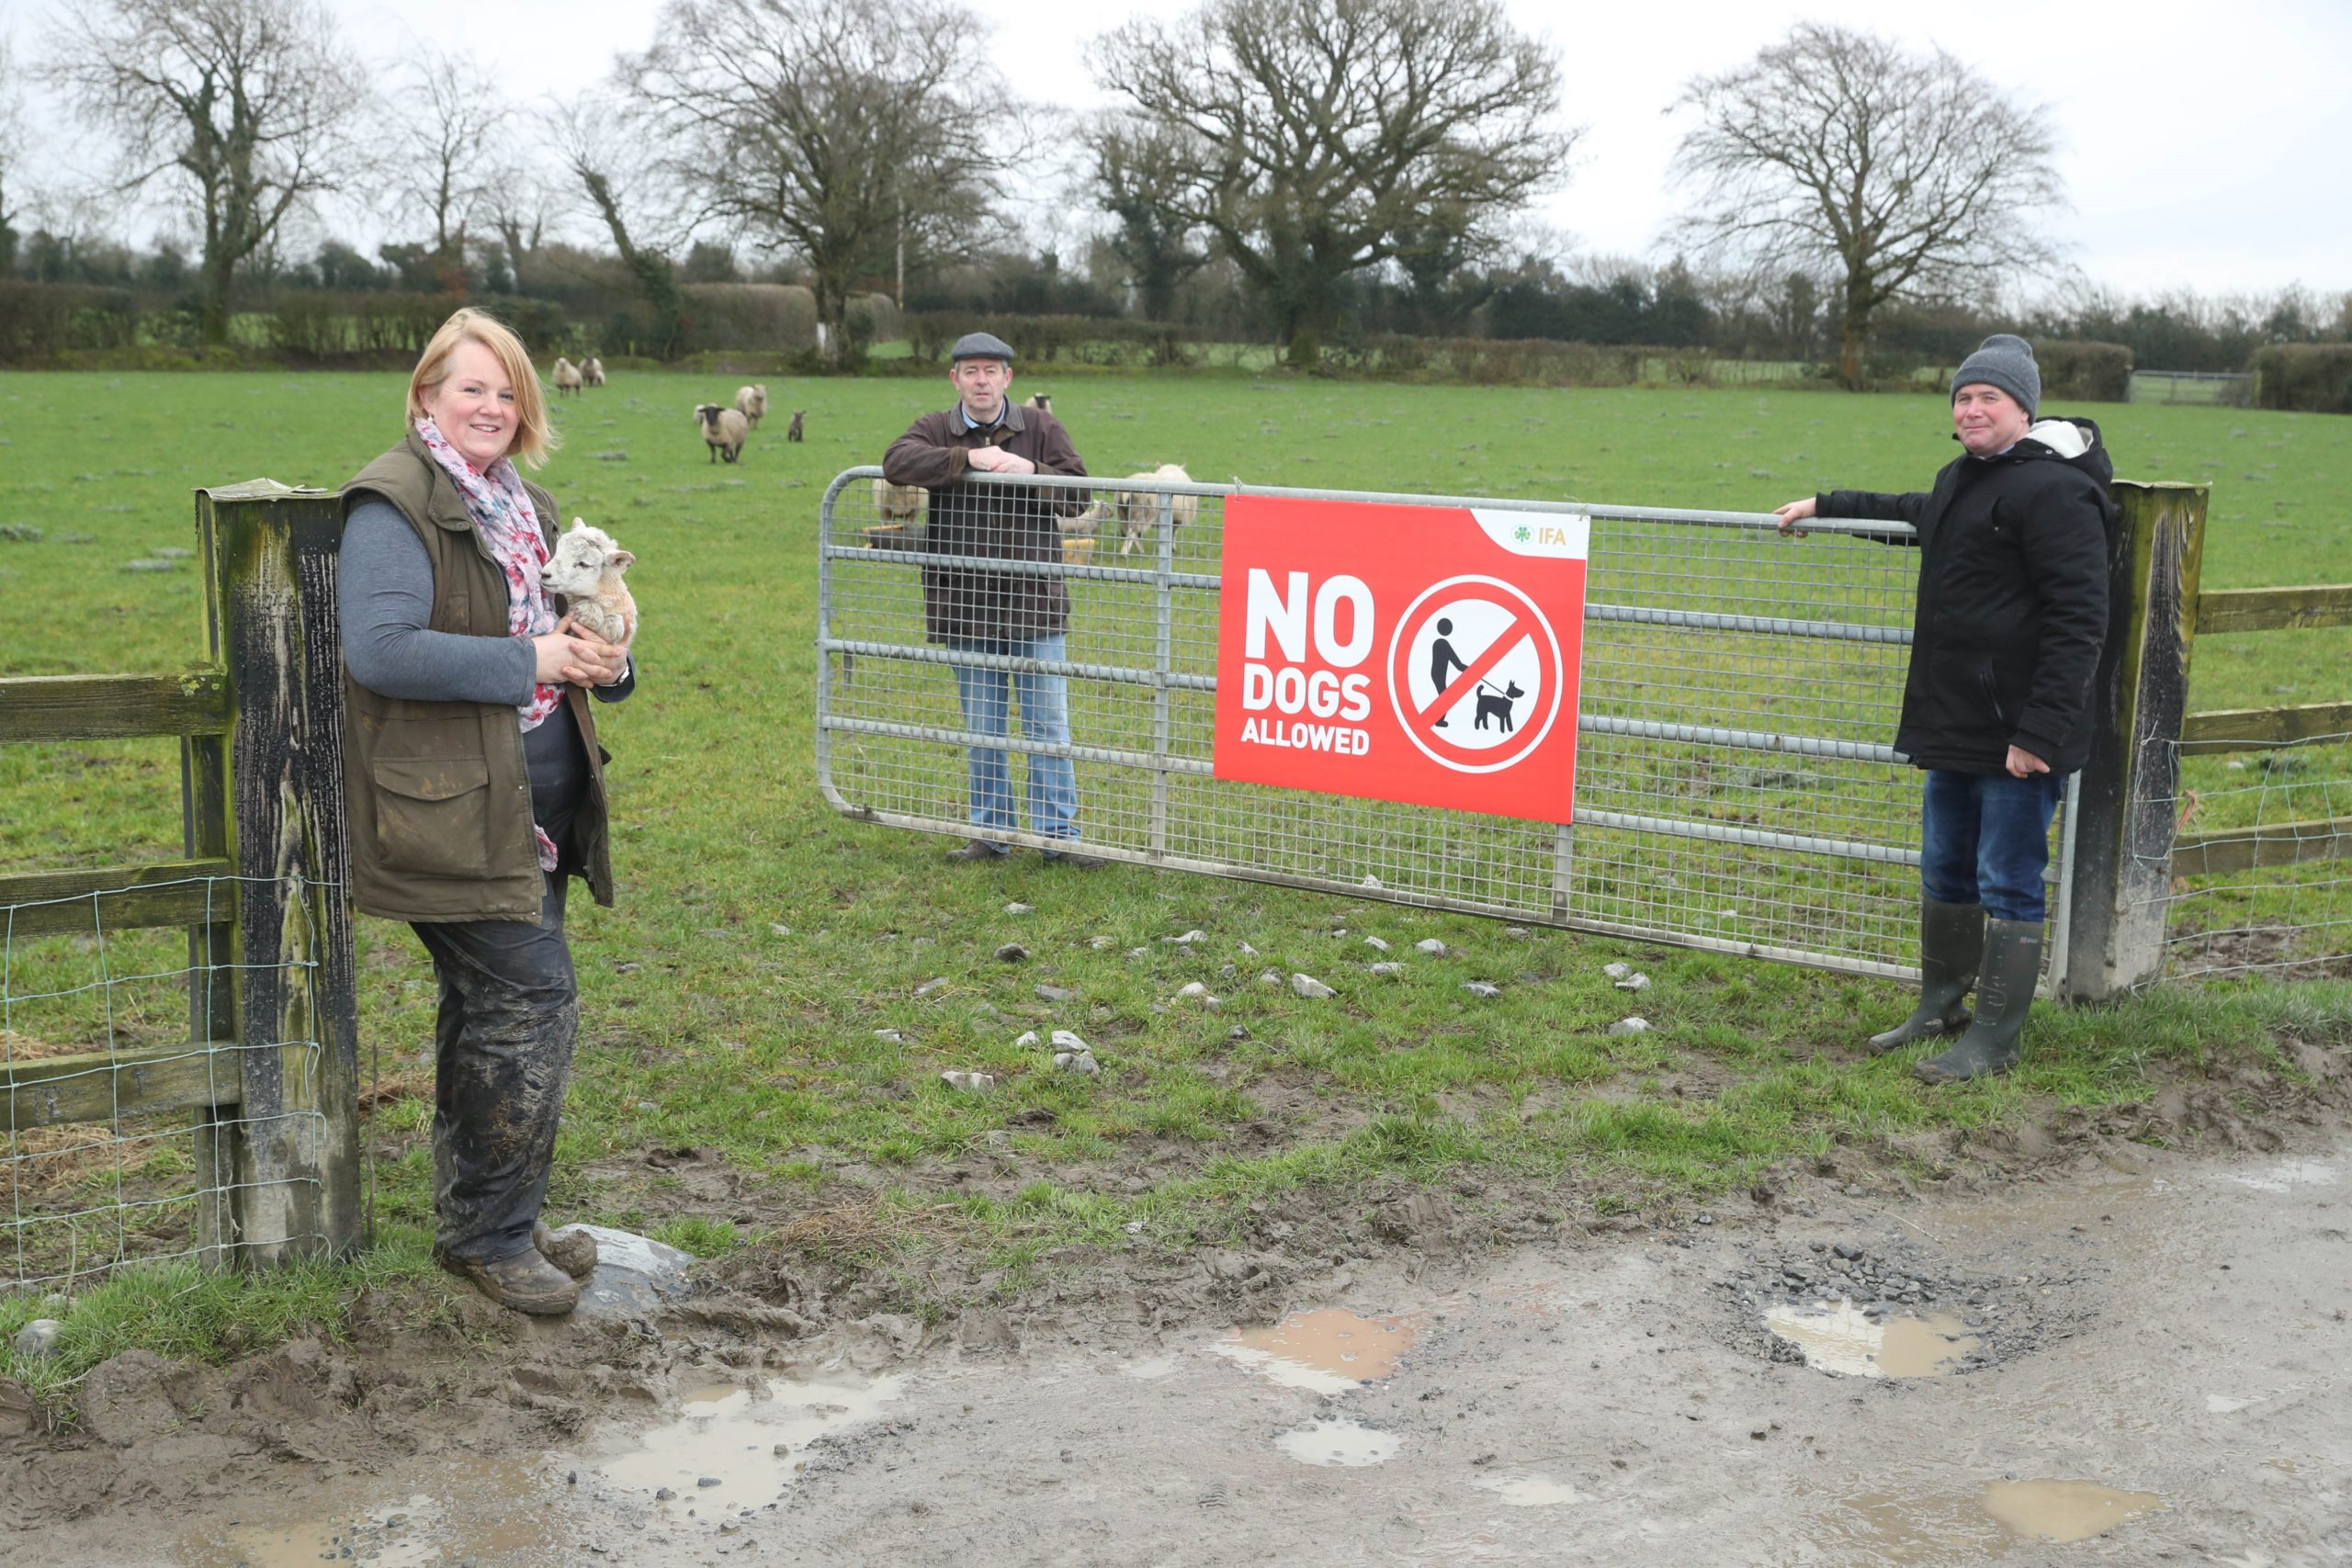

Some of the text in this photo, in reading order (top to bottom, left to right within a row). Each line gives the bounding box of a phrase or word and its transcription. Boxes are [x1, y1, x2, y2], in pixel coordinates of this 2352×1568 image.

[1538, 527, 1566, 546] IFA
[1244, 568, 1375, 668] NO
[1242, 662, 1372, 722] DOGS
[1240, 716, 1370, 756] ALLOWED
